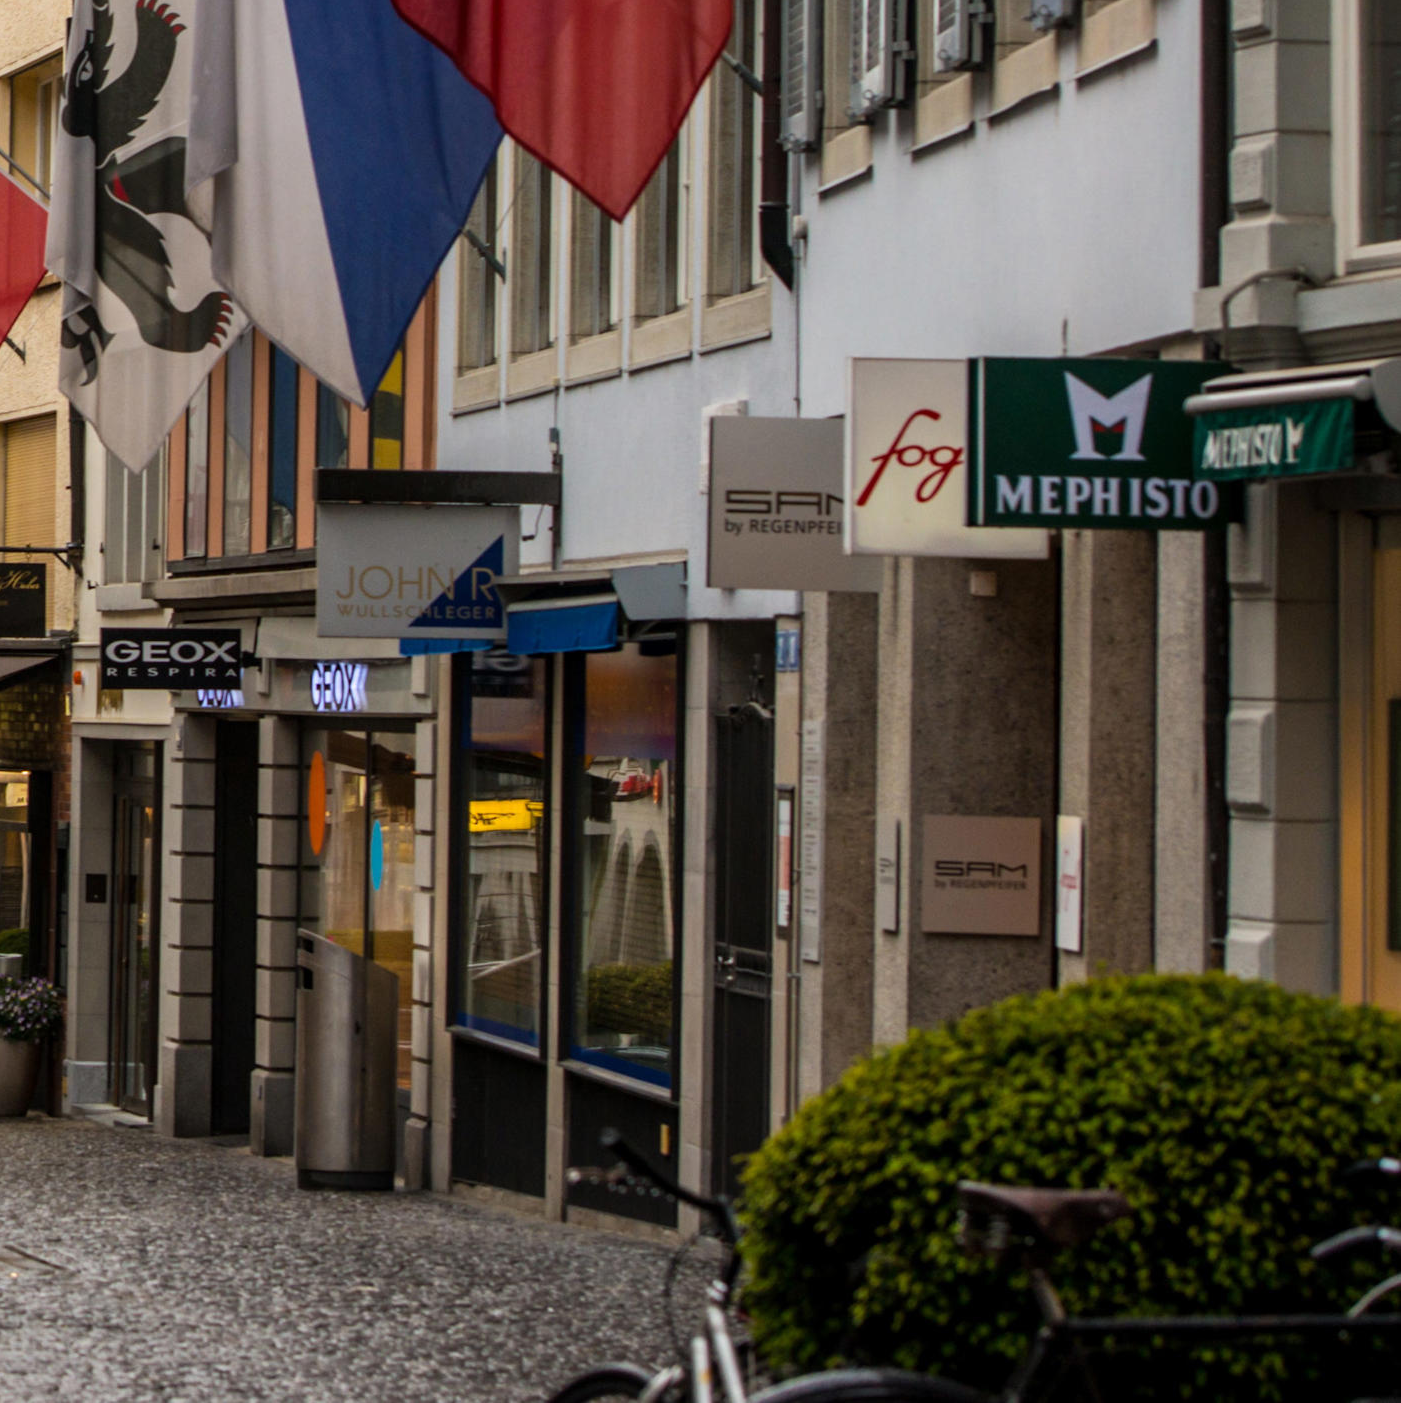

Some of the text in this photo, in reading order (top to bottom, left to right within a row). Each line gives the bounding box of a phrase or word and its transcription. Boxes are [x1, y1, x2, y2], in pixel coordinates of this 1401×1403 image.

[1200, 423, 1284, 470] MEPHISTO
[994, 474, 1219, 519] MEPHISTO
[724, 518, 843, 535] by REGENPFEI
[335, 564, 497, 601] JOHN R
[336, 604, 496, 620] WULLSCHLEGER
[105, 640, 238, 664] GEOX
[106, 667, 238, 678] RESPIRA
[310, 663, 365, 712] GEOX
[934, 860, 1027, 879] SAM
[934, 878, 947, 890] by
